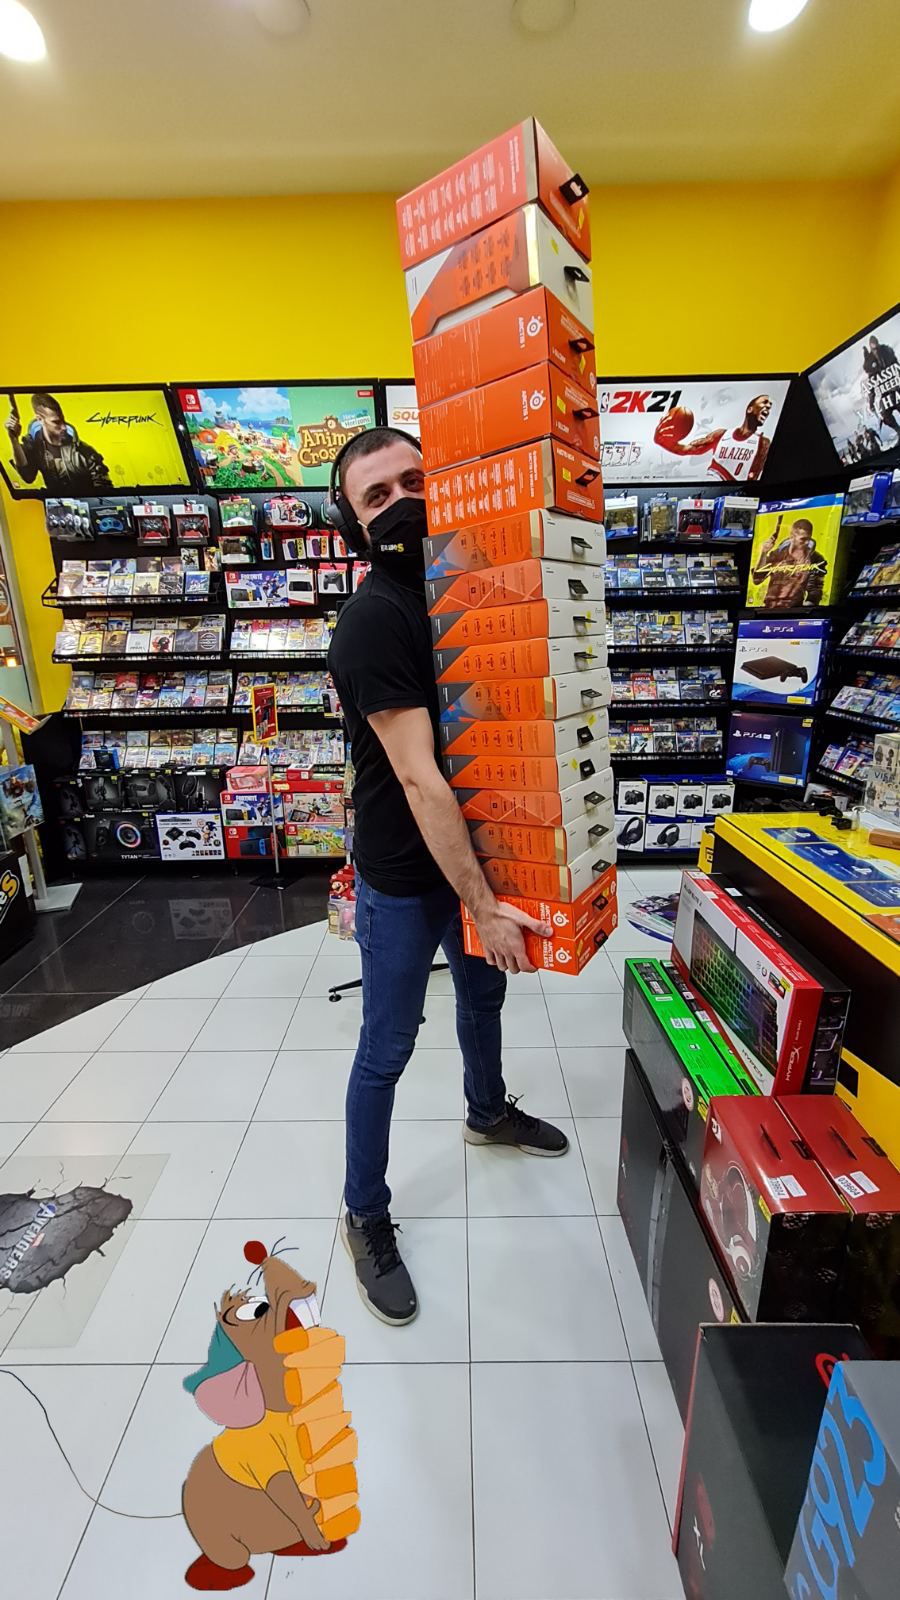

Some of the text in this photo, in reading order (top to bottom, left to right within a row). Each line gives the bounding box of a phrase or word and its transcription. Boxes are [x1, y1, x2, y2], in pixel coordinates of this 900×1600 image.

[608, 390, 682, 414] 2K21
[392, 411, 419, 421] SQU
[302, 427, 362, 449] Anima
[299, 448, 337, 464] Cros
[718, 446, 754, 461] BLAZERS
[734, 463, 744, 476] 0
[743, 731, 763, 739] PS4
[0, 1203, 57, 1277] AVENGERS
